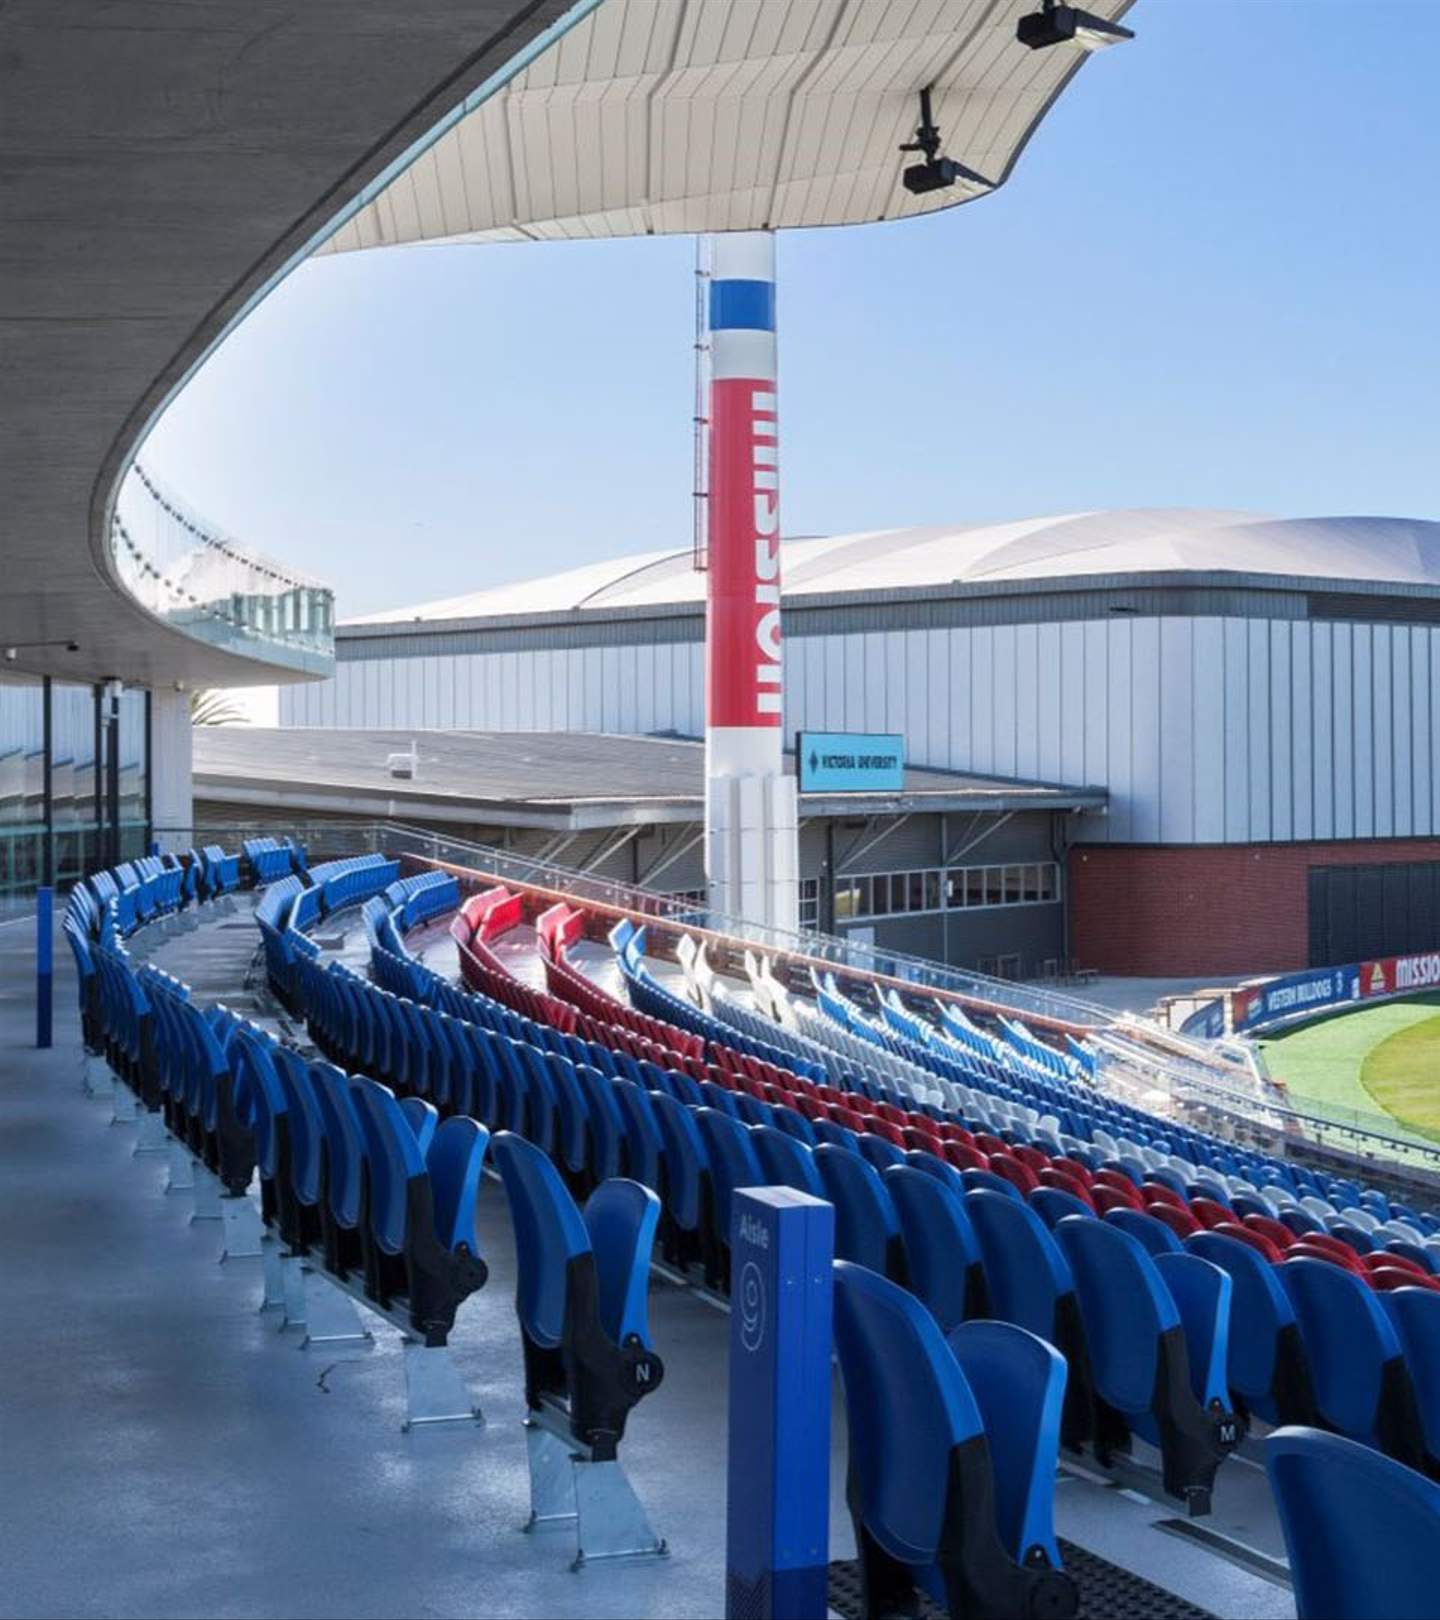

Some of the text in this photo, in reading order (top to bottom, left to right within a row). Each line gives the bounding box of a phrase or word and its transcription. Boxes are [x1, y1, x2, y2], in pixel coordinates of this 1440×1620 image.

[740, 1213, 769, 1249] Aisle
[636, 1364, 650, 1381] N
[1220, 1424, 1236, 1442] M
